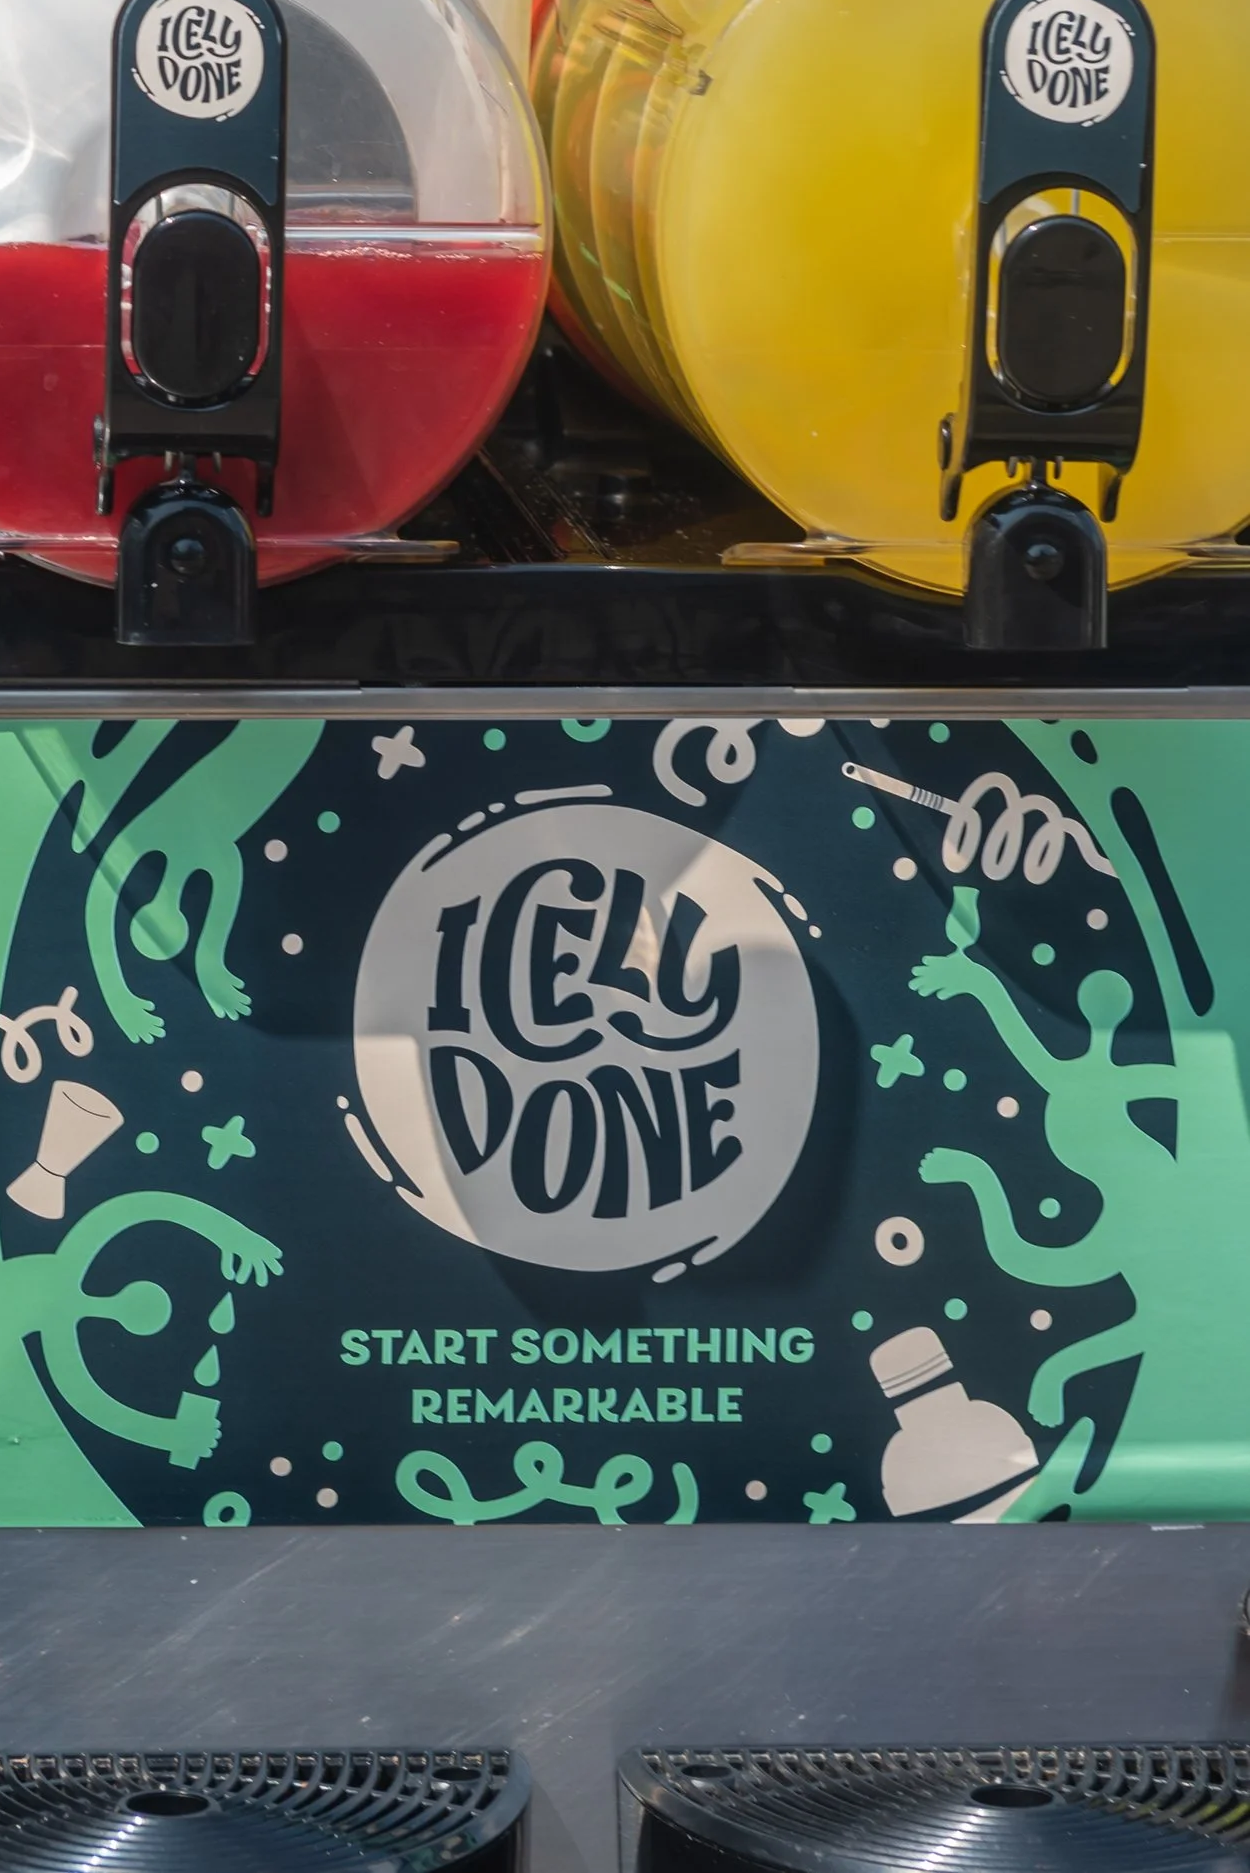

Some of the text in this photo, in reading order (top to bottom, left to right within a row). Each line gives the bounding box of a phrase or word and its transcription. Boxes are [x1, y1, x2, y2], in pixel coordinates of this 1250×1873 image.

[157, 5, 242, 60] ICELY
[1027, 10, 1112, 65] ICELY
[157, 55, 242, 103] DONE
[1027, 58, 1110, 108] DONE
[427, 858, 742, 1063] ICELY
[429, 1045, 743, 1220] DONE
[339, 1326, 815, 1365] START SOMETHING
[411, 1386, 743, 1424] REMARKABLE
